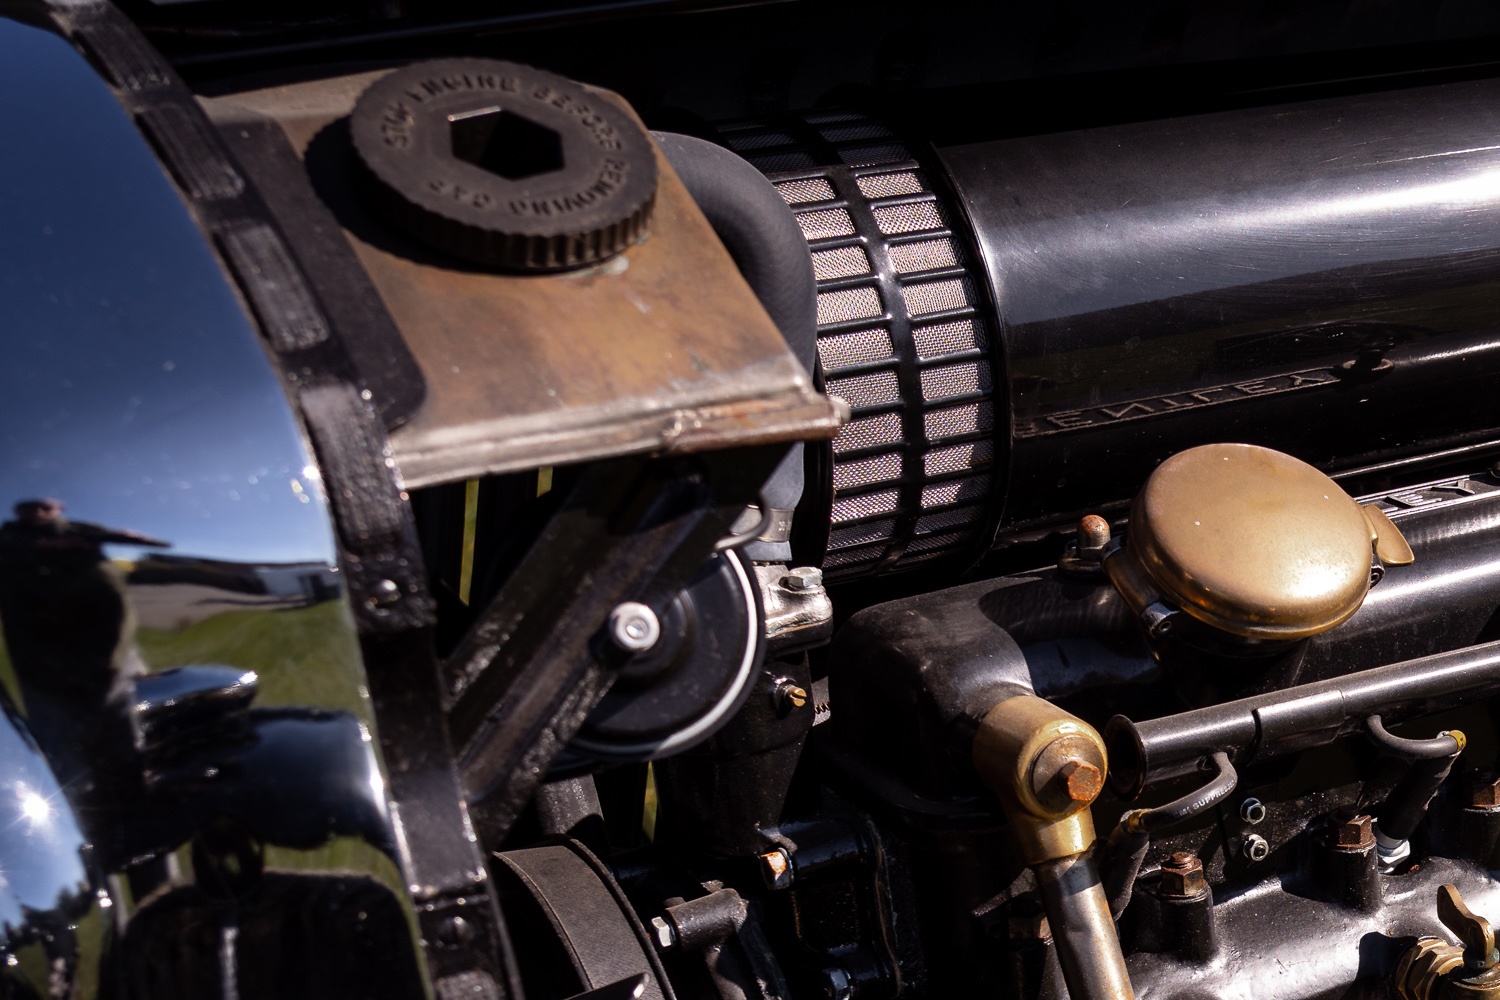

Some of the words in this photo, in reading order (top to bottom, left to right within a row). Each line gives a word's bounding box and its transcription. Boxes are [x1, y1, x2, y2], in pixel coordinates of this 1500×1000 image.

[404, 74, 520, 102] ENGINE
[533, 86, 623, 151] BEFORE
[508, 157, 629, 217] REMOVING
